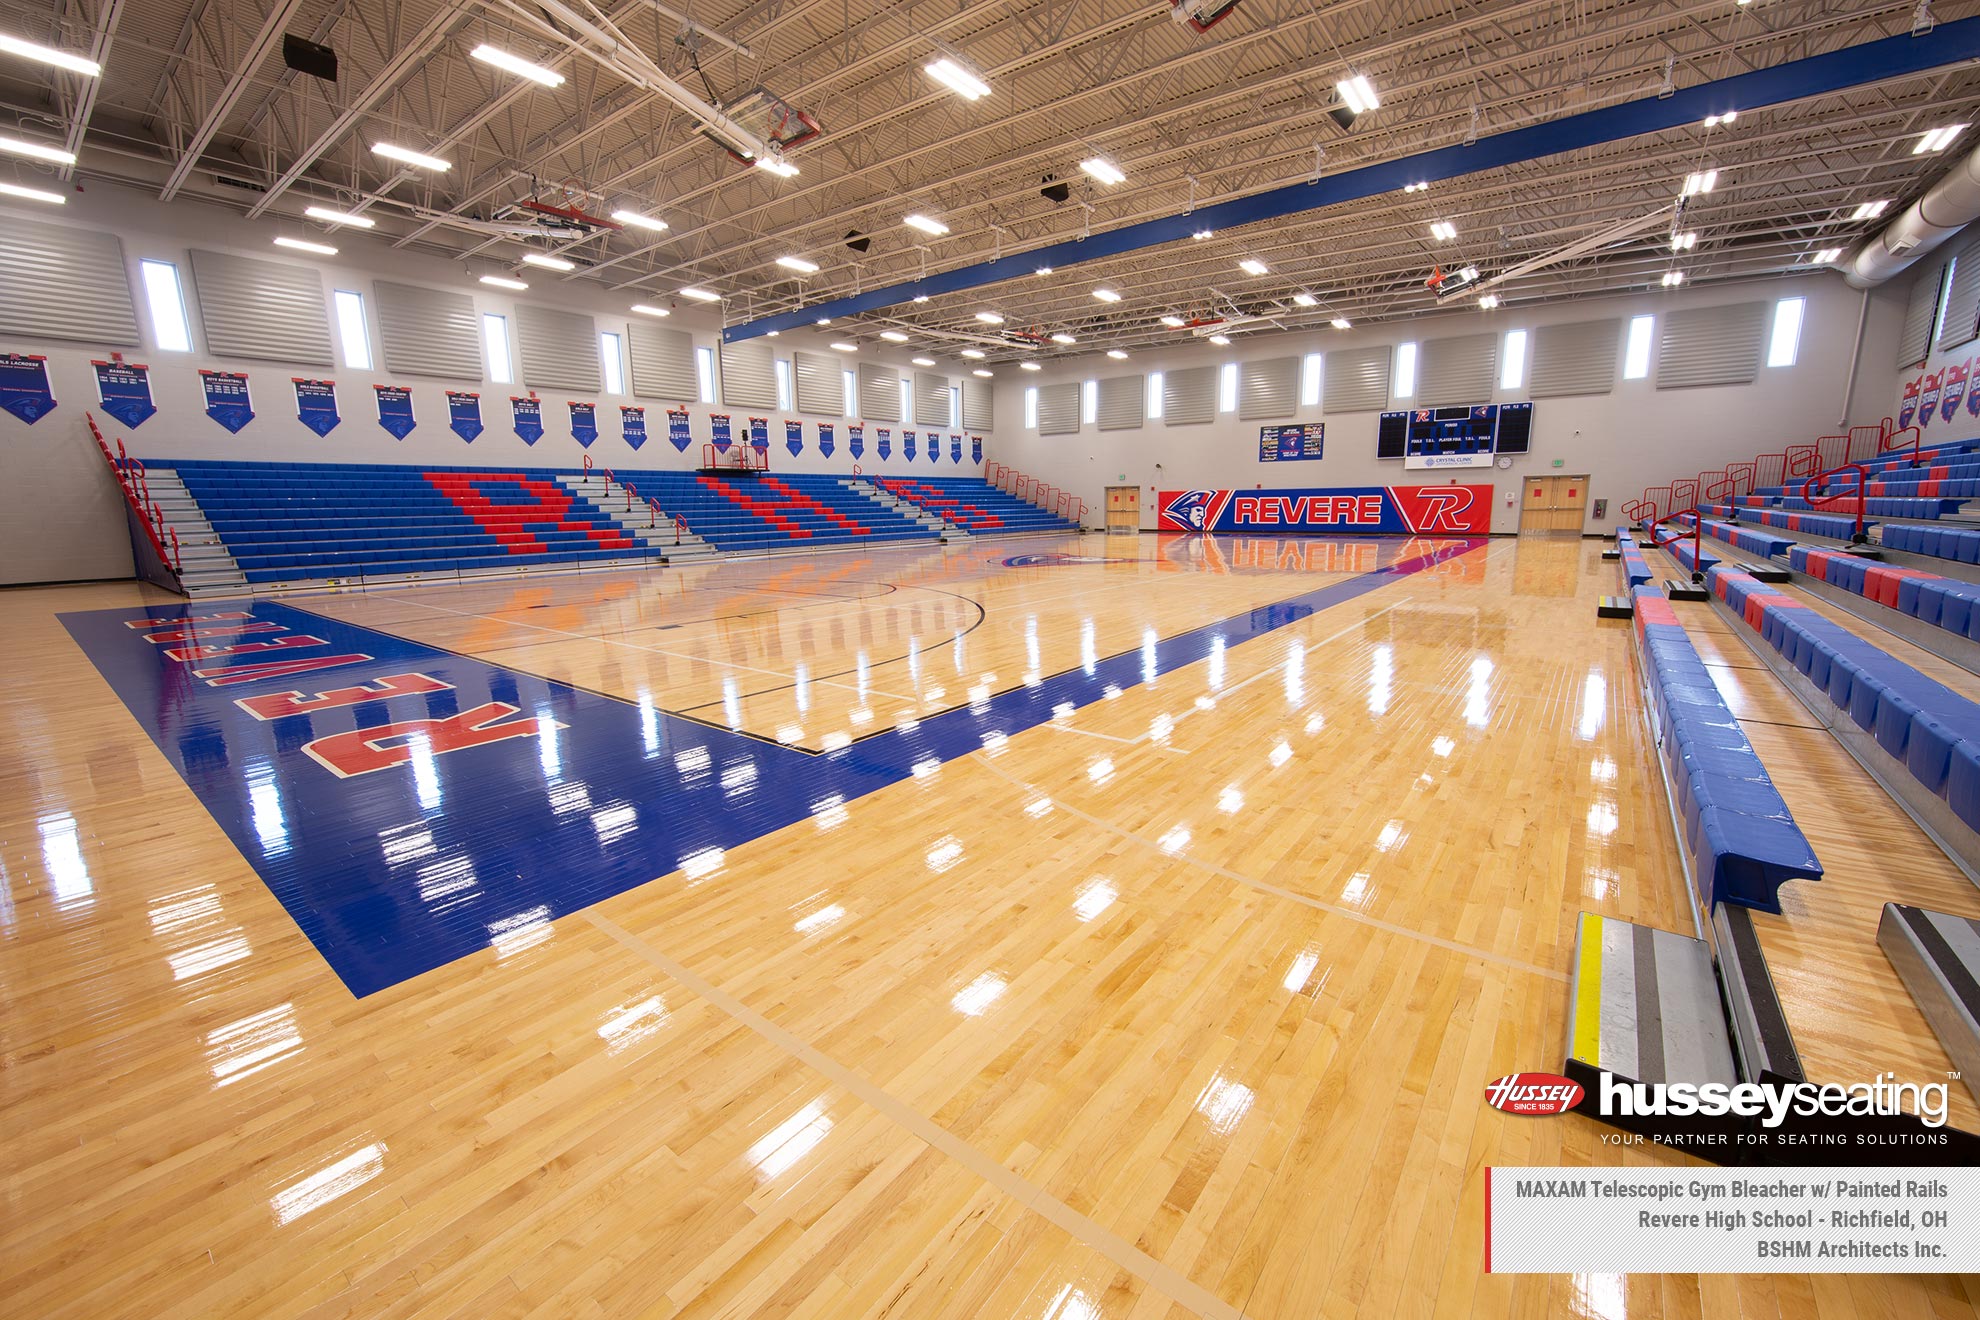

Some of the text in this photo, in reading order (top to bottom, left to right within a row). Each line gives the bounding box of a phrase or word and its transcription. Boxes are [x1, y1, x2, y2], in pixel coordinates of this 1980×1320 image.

[1414, 409, 1430, 422] R
[1234, 496, 1383, 524] REVERE
[1416, 487, 1475, 531] R
[124, 611, 570, 778] REVERE
